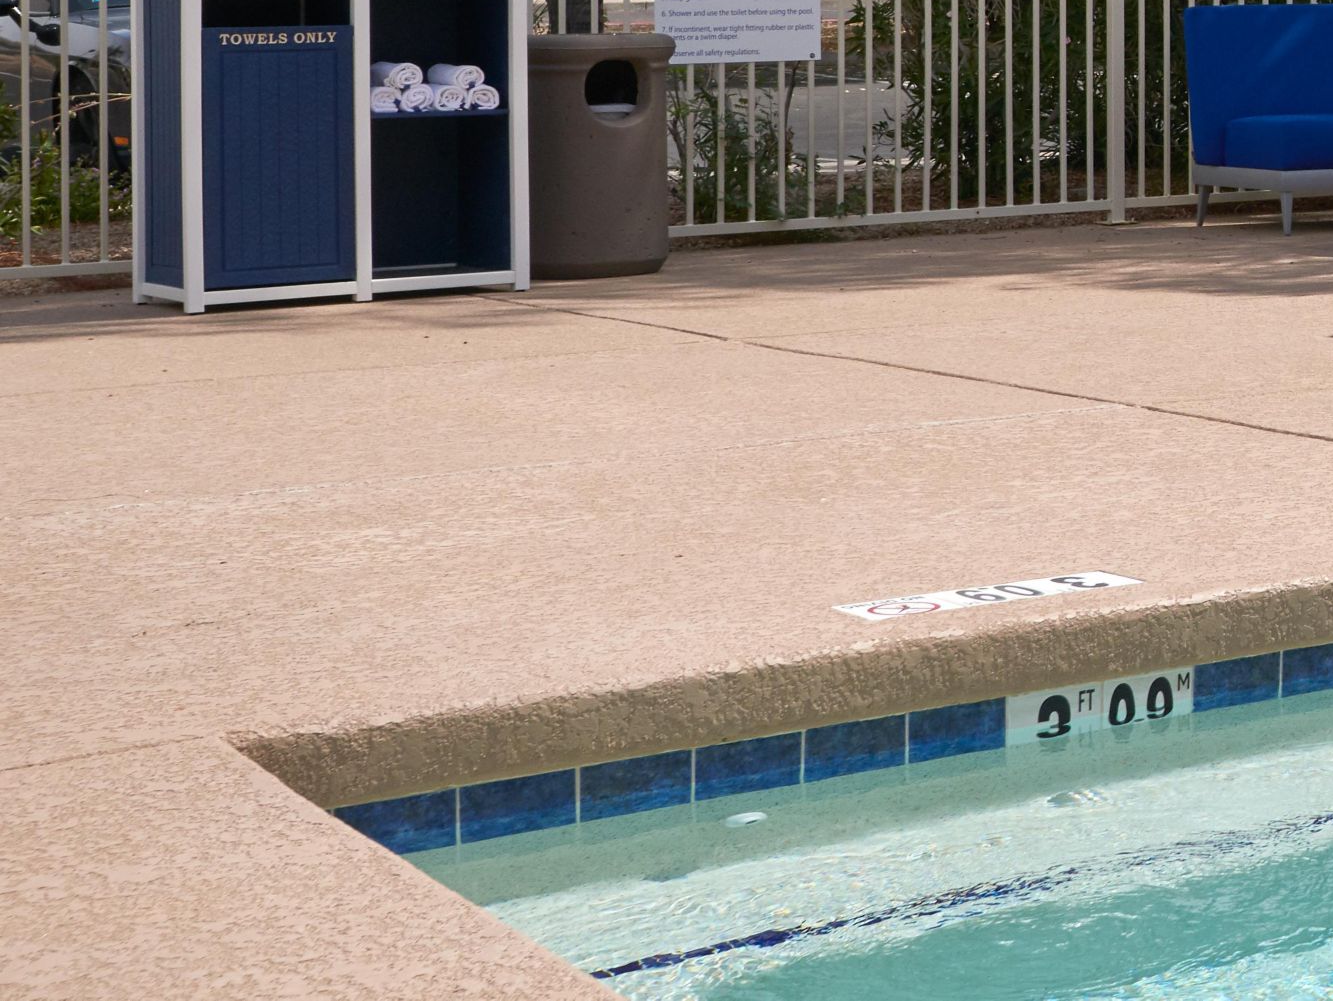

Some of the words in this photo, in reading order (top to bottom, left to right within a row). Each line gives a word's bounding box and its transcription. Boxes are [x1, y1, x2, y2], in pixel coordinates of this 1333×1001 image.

[219, 33, 288, 45] TOWELS
[293, 31, 337, 44] ONLY
[1036, 694, 1072, 739] 3
[1078, 688, 1096, 712] FT
[1177, 672, 1191, 692] M
